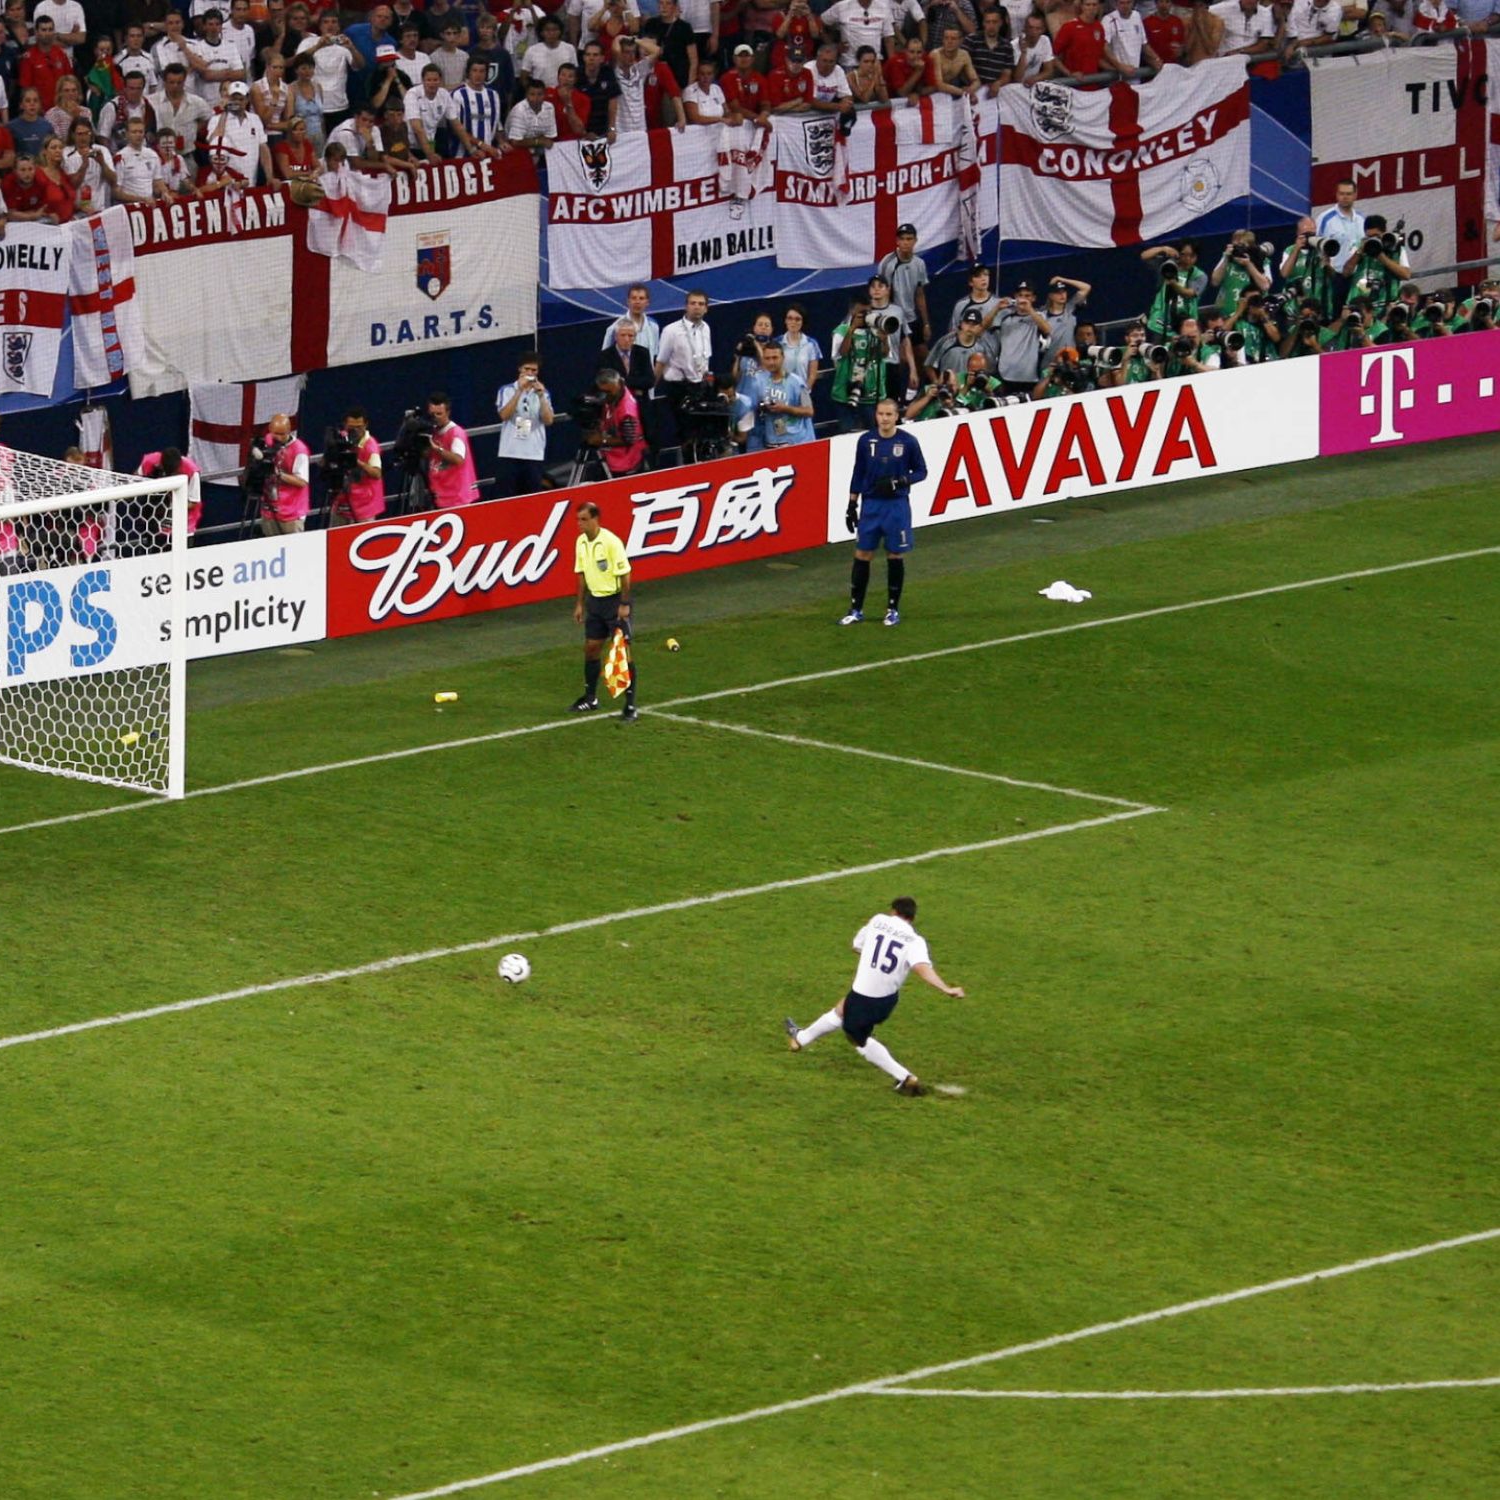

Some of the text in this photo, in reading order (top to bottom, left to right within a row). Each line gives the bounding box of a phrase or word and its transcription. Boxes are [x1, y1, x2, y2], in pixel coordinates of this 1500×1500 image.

[1038, 110, 1217, 177] CONONLEY
[130, 157, 495, 246] DAGENAM BRIDGE
[553, 177, 722, 220] AFC WIMBLE
[677, 226, 774, 268] HAND BALL!
[1361, 347, 1415, 444] T
[869, 443, 876, 457] 1
[928, 383, 1217, 517] AVAYA
[626, 464, 796, 561] 百威
[233, 547, 286, 585] and
[348, 500, 571, 622] Bud
[160, 594, 306, 644] smplicity
[871, 934, 904, 975] 15
